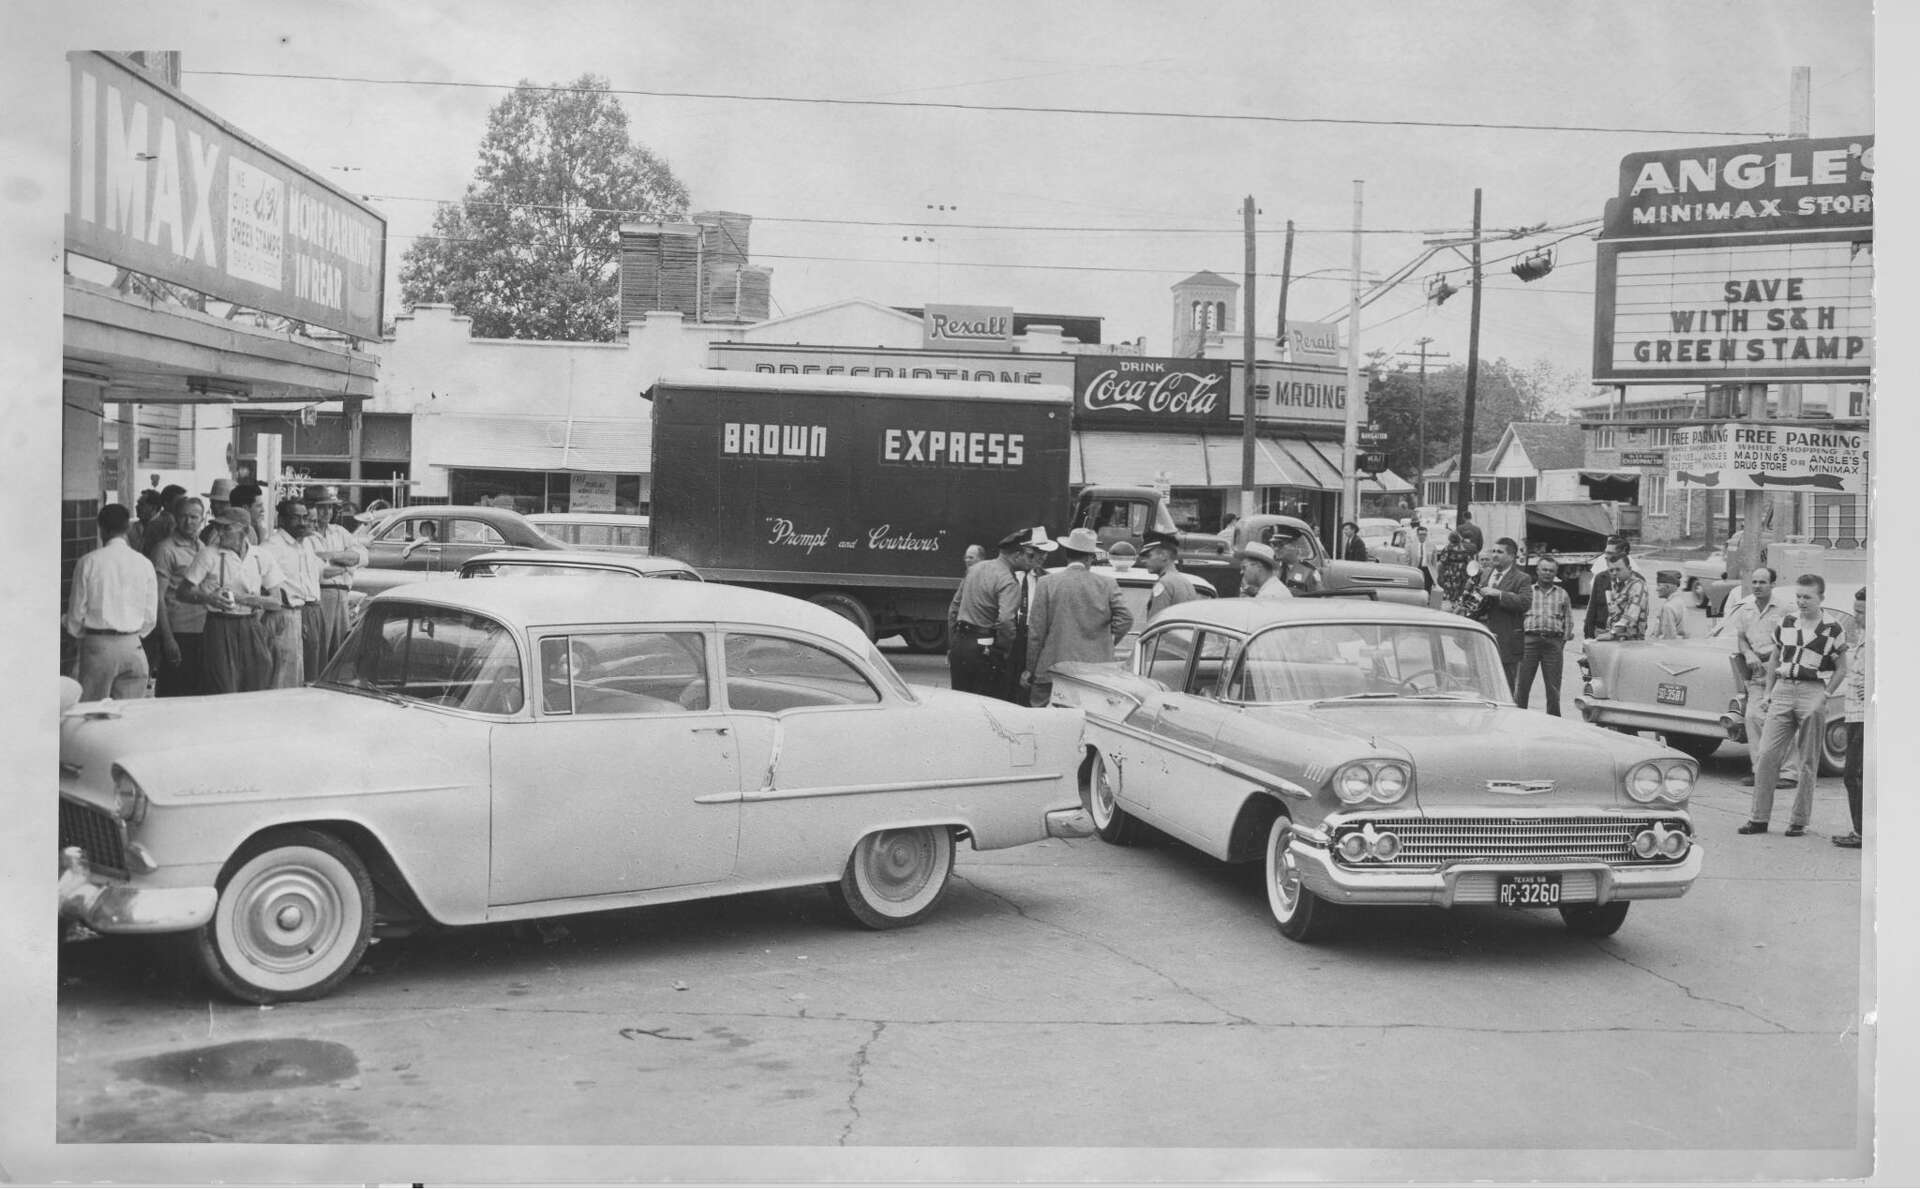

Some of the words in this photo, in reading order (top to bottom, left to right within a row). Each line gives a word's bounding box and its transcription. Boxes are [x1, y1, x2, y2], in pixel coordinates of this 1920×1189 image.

[64, 60, 220, 268] IMAX
[288, 186, 325, 248] MORE
[1632, 199, 1782, 225] MINIMAX
[295, 252, 310, 299] IN
[311, 258, 342, 310] REAR
[1724, 277, 1803, 303] SAVE
[929, 313, 1008, 341] Rexall
[1670, 309, 1749, 333] WITH
[1292, 329, 1336, 355] Rexall
[1120, 361, 1166, 372] DRINK
[1084, 369, 1224, 413] Coca-Cola
[724, 423, 827, 457] BROWN
[885, 429, 1024, 465] EXPRESS
[1671, 431, 1689, 446] FREE
[1692, 429, 1729, 444] PARKING
[1735, 429, 1776, 444] FREE
[1786, 432, 1861, 448] PARKING
[1734, 451, 1788, 462] MADING'S
[1778, 445, 1838, 455] SHOPPING
[1809, 455, 1860, 466] ANGLE'S
[1734, 461, 1757, 470] DRUG
[1760, 462, 1787, 471] STORE
[1809, 465, 1858, 475] MINIMAX
[838, 539, 858, 549] and
